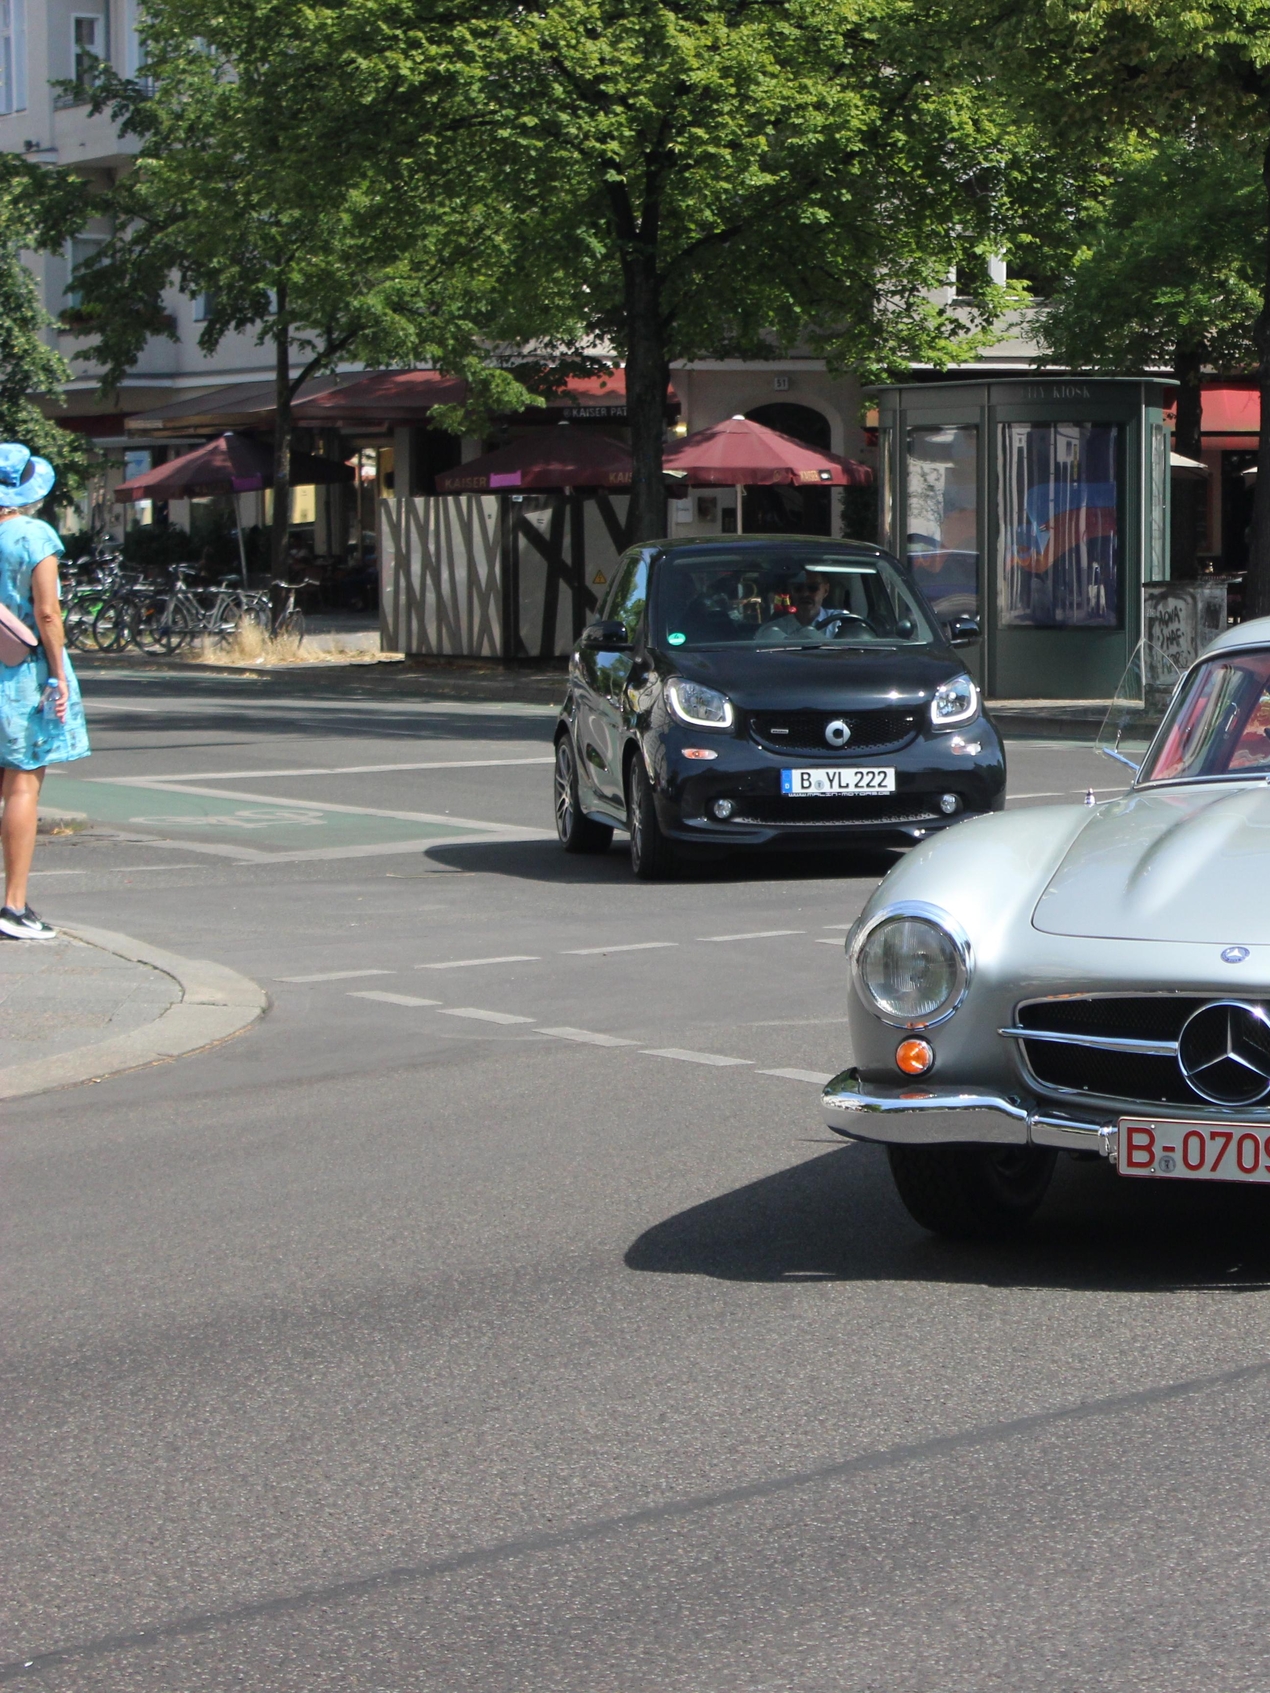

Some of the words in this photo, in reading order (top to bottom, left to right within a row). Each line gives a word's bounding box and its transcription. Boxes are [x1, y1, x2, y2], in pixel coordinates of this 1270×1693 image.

[776, 376, 786, 387] 51
[1053, 386, 1091, 398] KIOSK
[572, 407, 607, 417] KAISER
[445, 477, 488, 489] KAISER
[800, 772, 812, 789] B
[826, 771, 849, 789] YL
[854, 770, 888, 788] 222
